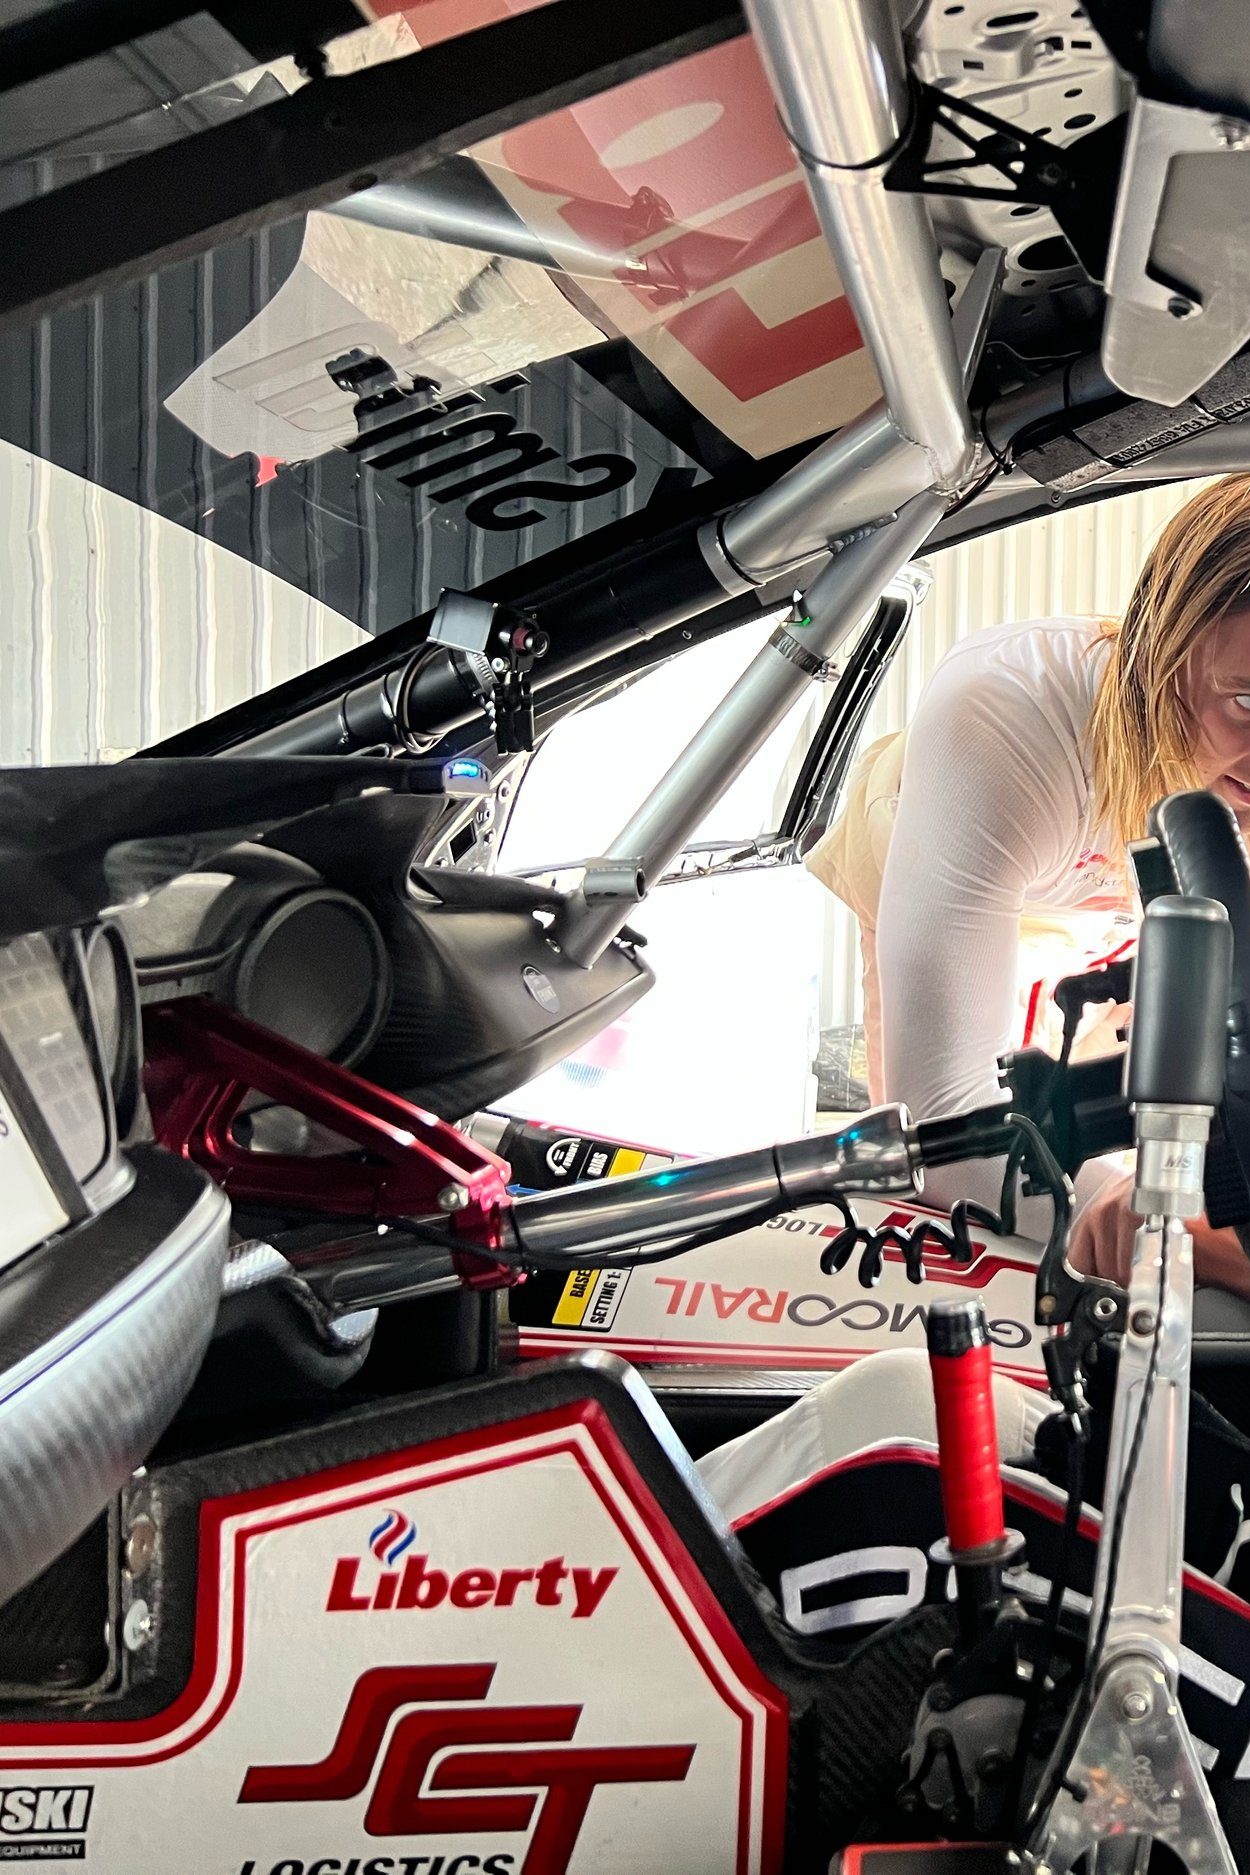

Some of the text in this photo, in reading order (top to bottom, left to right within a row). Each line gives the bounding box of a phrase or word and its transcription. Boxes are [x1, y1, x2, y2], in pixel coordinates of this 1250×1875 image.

[562, 1143, 580, 1167] FRONT
[587, 1152, 608, 1175] BIAS
[570, 1269, 593, 1297] BASE
[591, 1283, 617, 1323] SETTING
[653, 1277, 1032, 1349] GMCORAIL
[327, 1553, 620, 1619] Liberty
[237, 1663, 697, 1875] SCT
[0, 1788, 90, 1833] SKI
